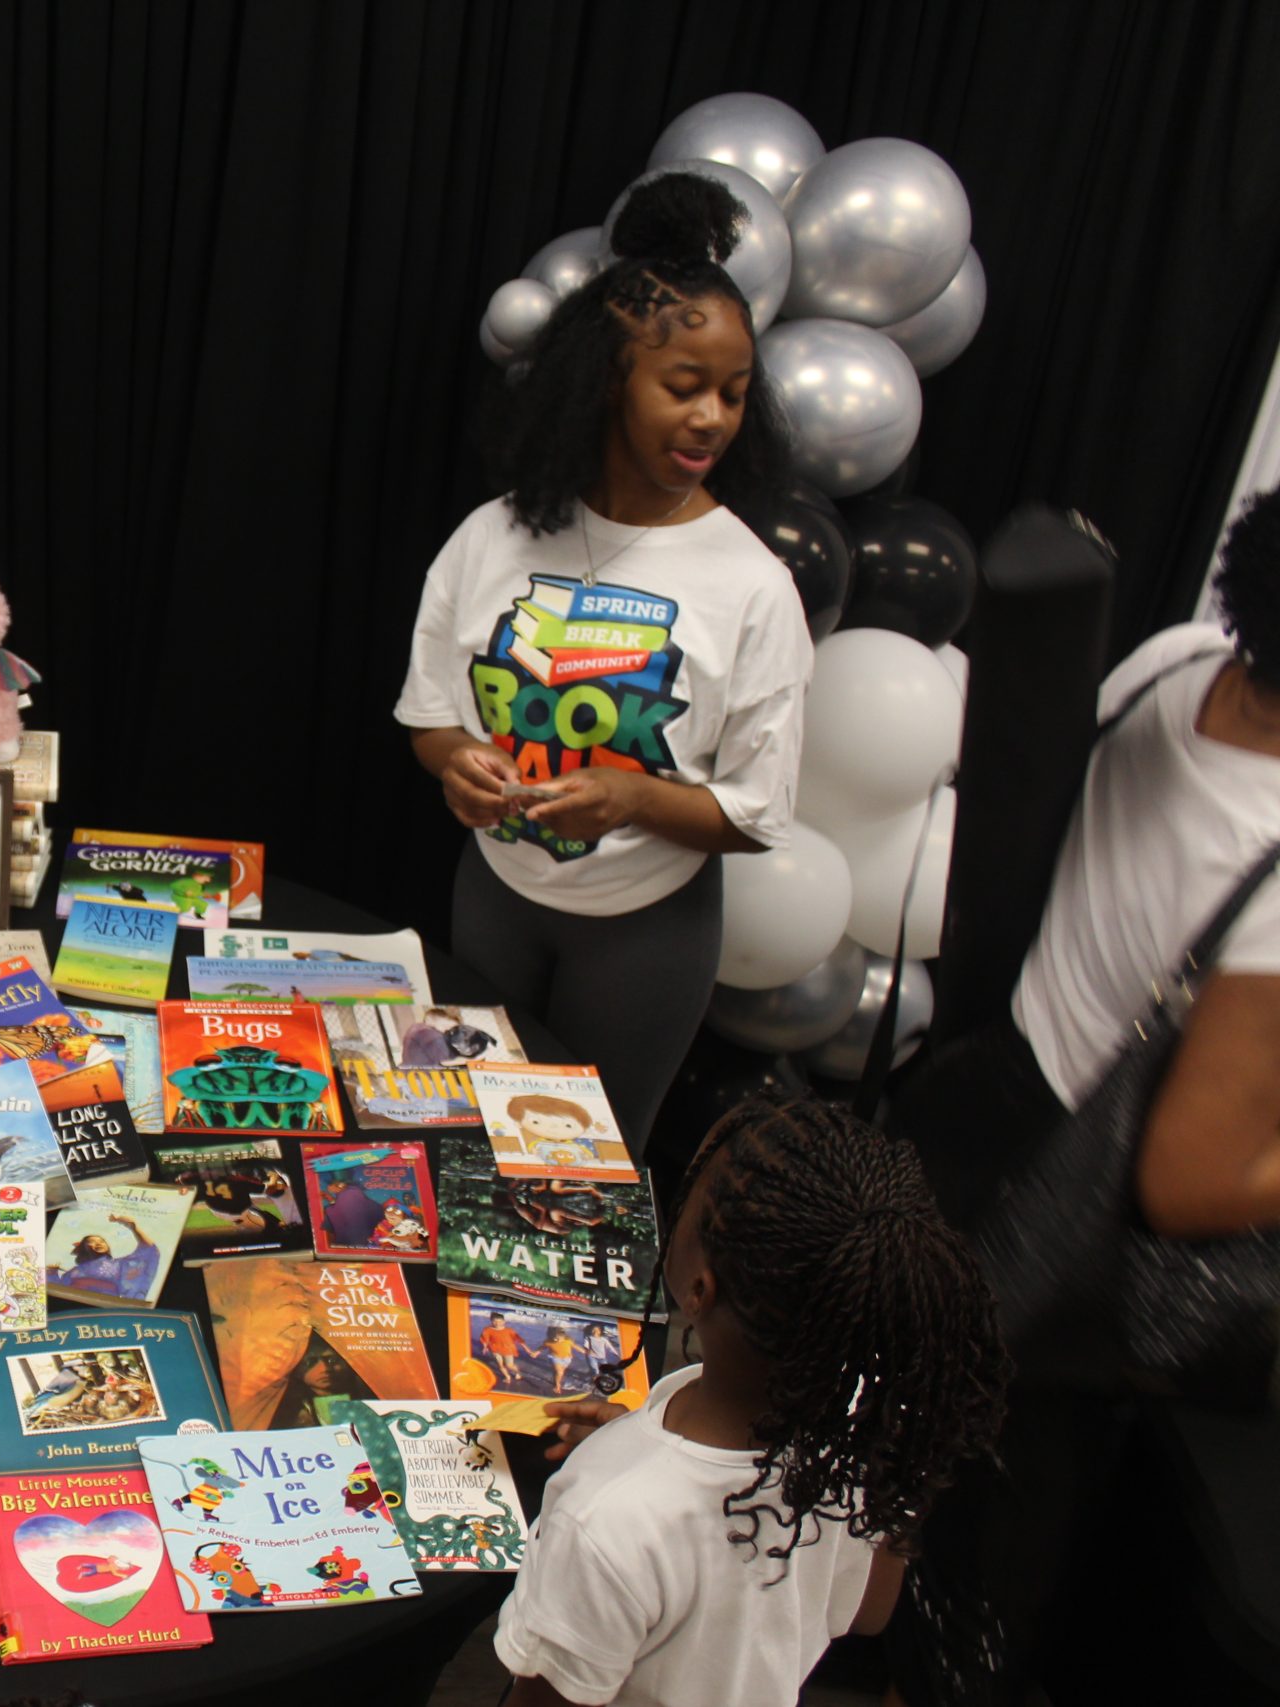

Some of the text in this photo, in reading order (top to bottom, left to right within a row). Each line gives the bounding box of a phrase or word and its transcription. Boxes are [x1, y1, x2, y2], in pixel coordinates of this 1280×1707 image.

[580, 596, 668, 621] SPRING
[565, 625, 644, 648] BREAK
[555, 653, 645, 675] COMMUNITY
[473, 663, 678, 762] BOOK
[77, 848, 141, 861] GOOD
[89, 860, 188, 875] GORILLA
[84, 904, 165, 926] NEVER
[84, 923, 164, 943] ALONE
[199, 968, 239, 977] PLAIN
[268, 961, 293, 970] THE
[296, 962, 328, 971] RAIN
[332, 963, 350, 972] TO
[200, 1015, 283, 1043] Bugs
[555, 1082, 565, 1090] A
[58, 1104, 108, 1127] LONG
[93, 1120, 121, 1138] TO
[65, 1140, 123, 1166] ATER
[161, 1152, 219, 1164] PLAYOFF
[5, 1189, 14, 1200] 2
[104, 1188, 157, 1204] Sadako
[205, 1181, 232, 1200] 14
[468, 1225, 630, 1257] A cool drink of
[460, 1232, 637, 1291] WATER
[317, 1268, 388, 1290] A Boy
[491, 1271, 506, 1281] by
[320, 1286, 397, 1307] Called
[327, 1305, 400, 1328] Slow
[13, 1327, 70, 1345] Baby
[76, 1324, 127, 1340] Blue
[132, 1323, 176, 1340] Jays
[366, 1331, 410, 1339] BRUCHAC
[46, 1444, 84, 1460] John
[402, 1439, 454, 1455] THE TRUTH
[230, 1446, 336, 1480] Mice
[407, 1458, 458, 1471] ABOUT MY
[18, 1474, 129, 1492] Little Mouse's
[283, 1481, 307, 1491] on
[408, 1474, 487, 1489] UNBELIEVABLE
[1, 1489, 154, 1514] Big Valentine
[264, 1492, 322, 1525] Ice
[196, 1525, 381, 1549] by Rebecca Emberley and Ed Emberley
[272, 1591, 339, 1601] SCHOLASTIC
[0, 1642, 10, 1655] E
[41, 1628, 181, 1654] by Thacher Hurd
